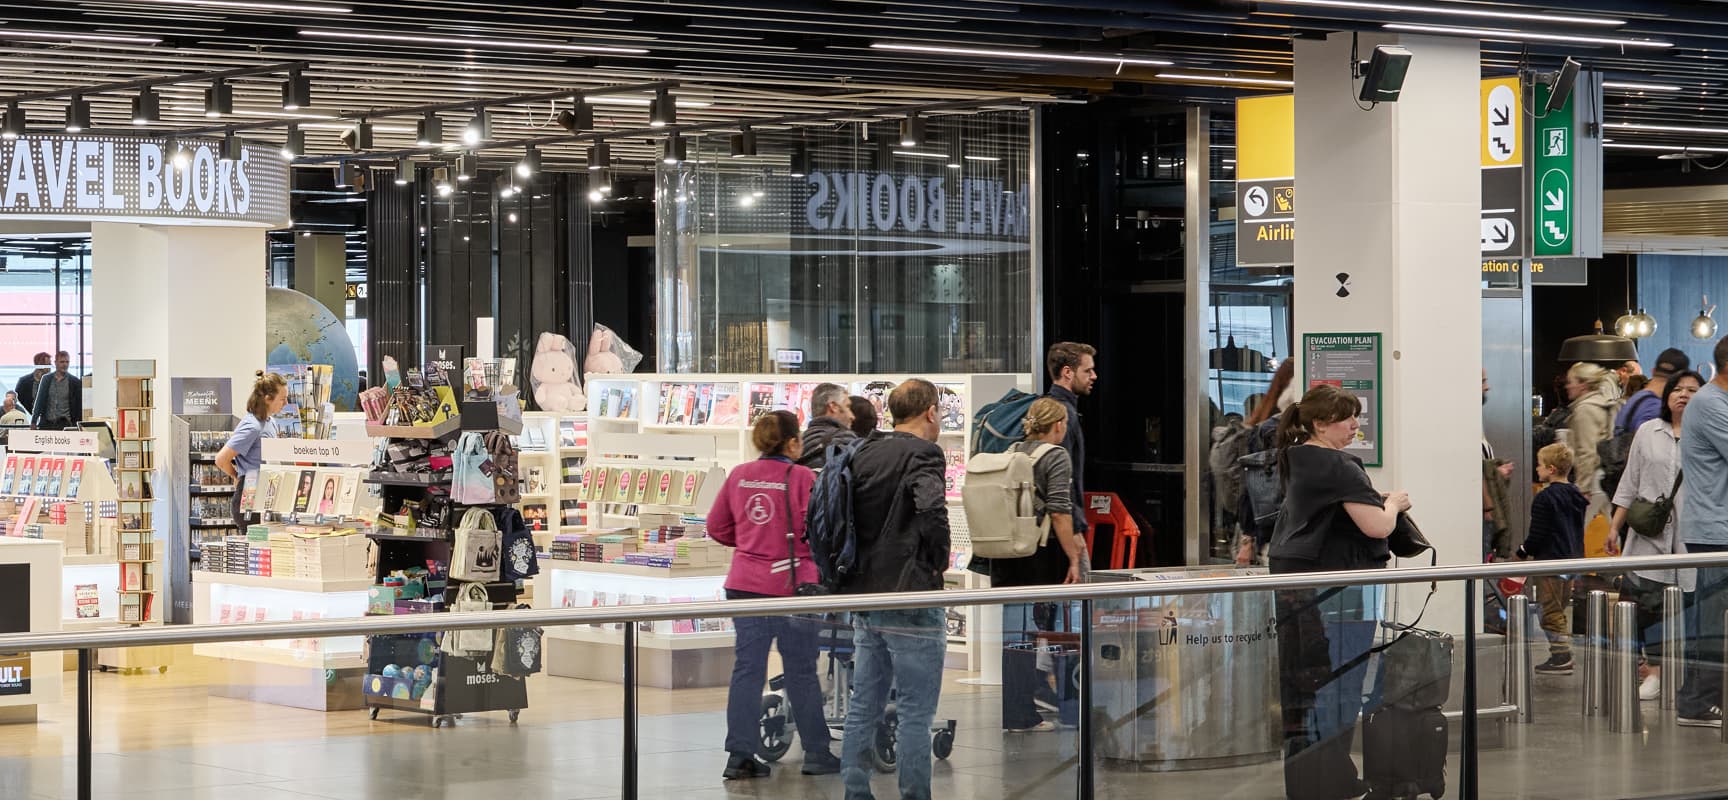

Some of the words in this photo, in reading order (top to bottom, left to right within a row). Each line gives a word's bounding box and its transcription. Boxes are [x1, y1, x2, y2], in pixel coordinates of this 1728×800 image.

[140, 143, 250, 215] BOOKS
[1310, 336, 1352, 345] EVACUATION
[1355, 336, 1372, 344] PLAN
[34, 435, 53, 446] English
[54, 435, 71, 444] books
[293, 445, 317, 455] boeken
[318, 446, 330, 456] top
[331, 446, 340, 456] 10
[1186, 634, 1209, 647] Help
[1212, 635, 1222, 643] us
[1224, 634, 1234, 643] to
[1236, 631, 1262, 645] recycle
[466, 672, 500, 685] moses.
